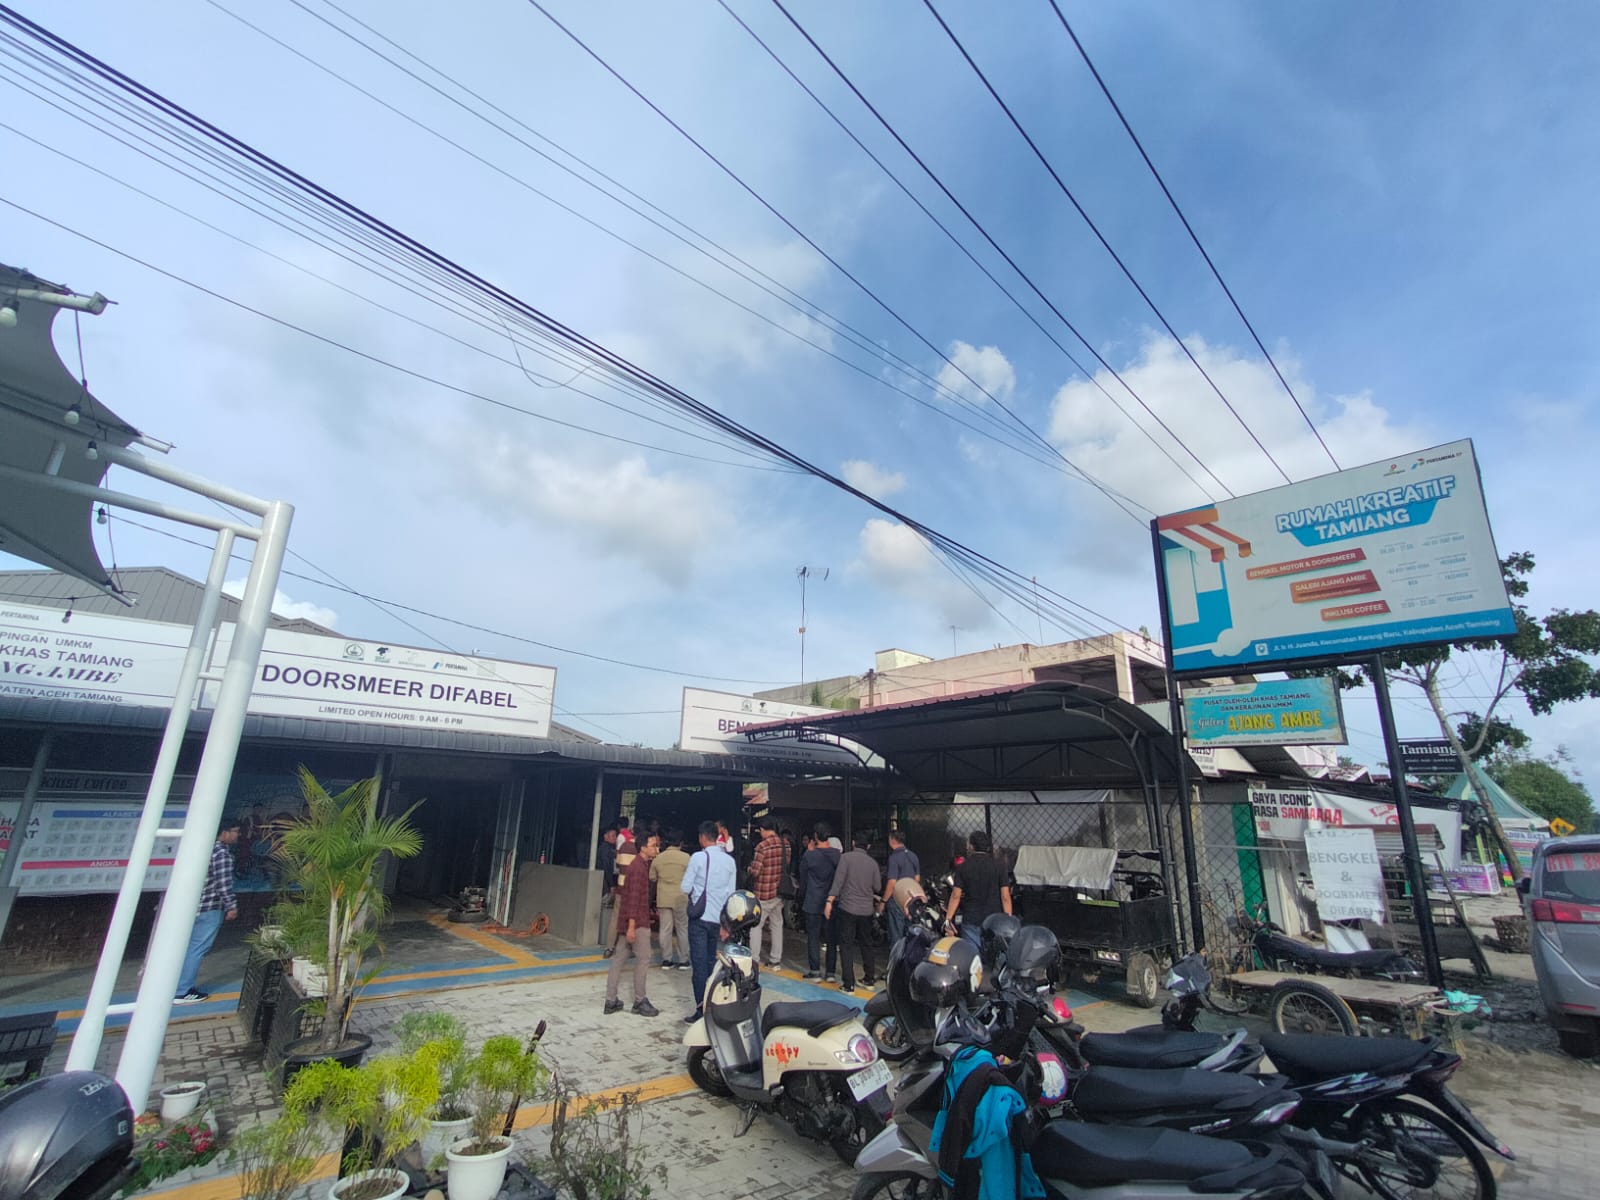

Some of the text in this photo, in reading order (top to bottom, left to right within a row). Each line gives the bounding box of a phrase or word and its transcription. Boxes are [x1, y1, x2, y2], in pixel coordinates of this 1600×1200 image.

[1276, 475, 1456, 533] RUMAH KREATIF
[1315, 508, 1411, 540] TAMIANG
[1279, 563, 1304, 572] MOTOR
[1354, 604, 1384, 614] COFFEE
[55, 638, 93, 649] UMKM
[0, 644, 134, 669] KHAS TAMIANG
[261, 664, 519, 710] DOORSMEER DIFABEL
[37, 688, 70, 699] ACEH
[73, 692, 123, 702] TAMIANG
[1280, 692, 1311, 700] TAMIANG
[318, 705, 355, 716] LIMITED
[357, 709, 382, 718] OPEN
[425, 715, 439, 723] AM
[451, 717, 463, 725] PM
[1228, 713, 1275, 731] AJANG
[1281, 710, 1323, 728] AMBE
[1399, 744, 1457, 756] Tamiang
[1252, 792, 1312, 806] GAYA ICONIC
[1254, 805, 1279, 818] RASA
[1309, 852, 1378, 864] BENGKEL
[1340, 871, 1352, 882] &
